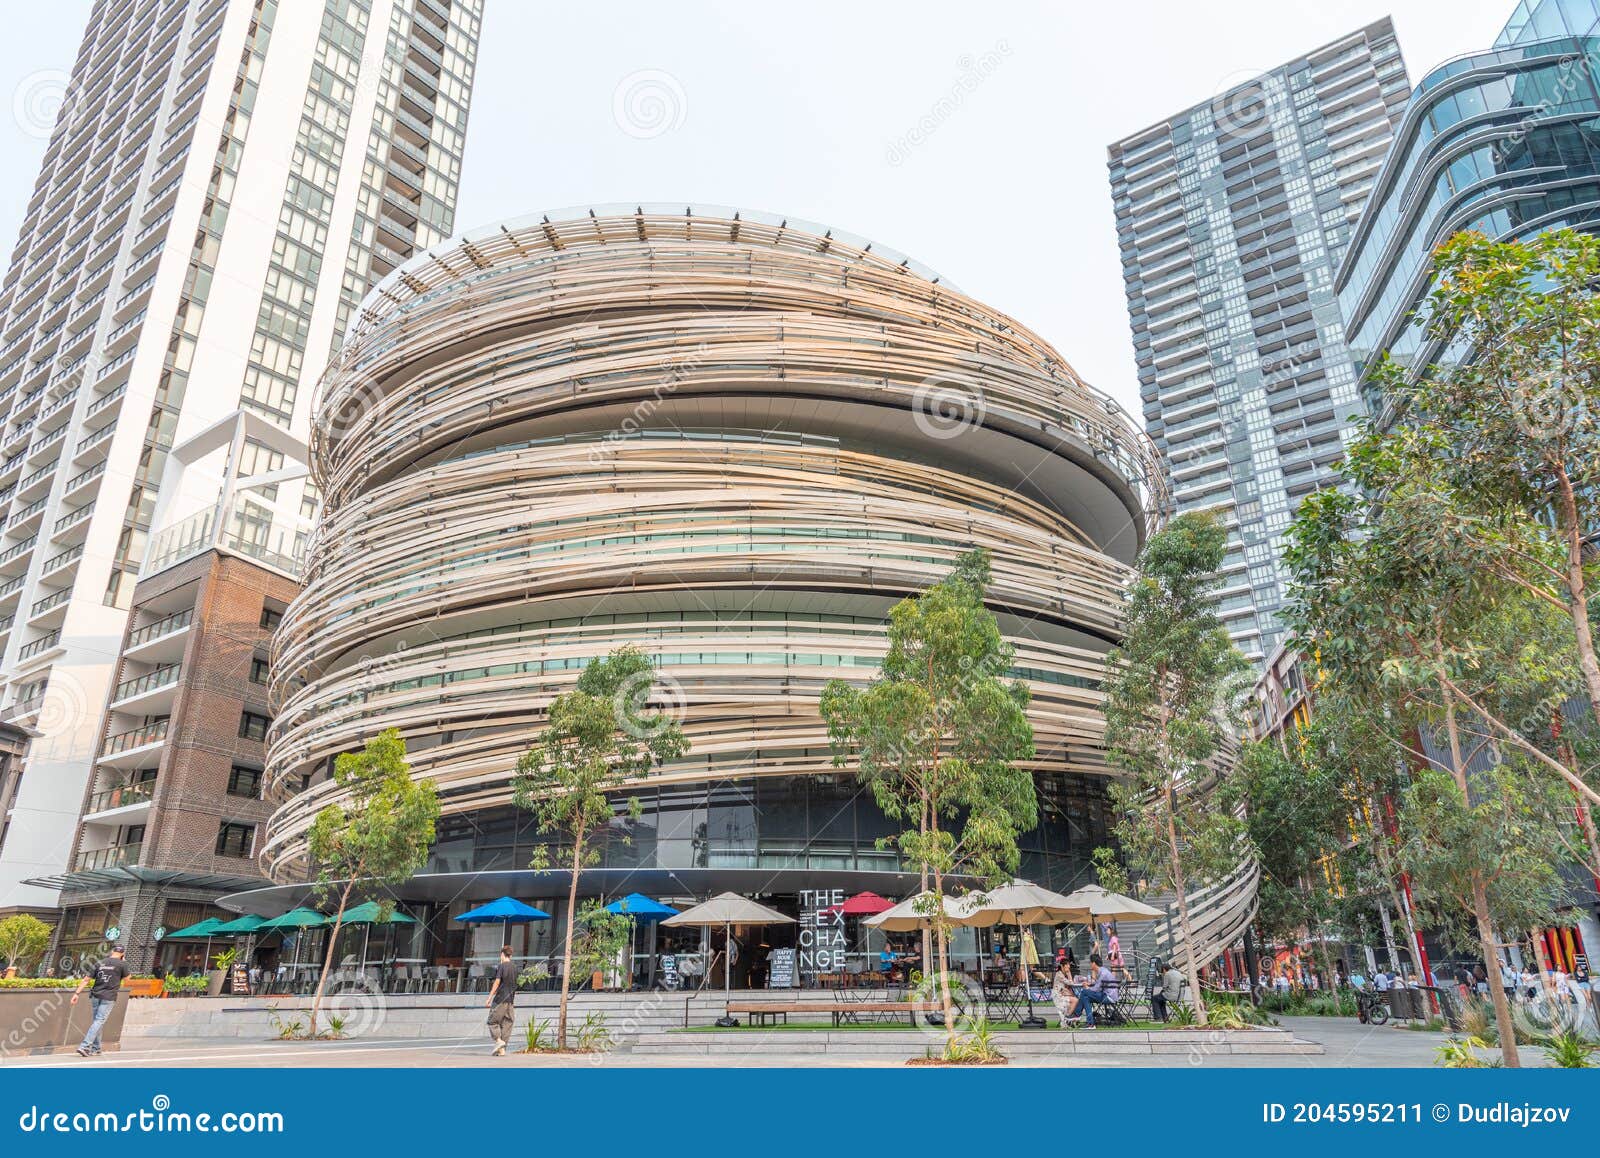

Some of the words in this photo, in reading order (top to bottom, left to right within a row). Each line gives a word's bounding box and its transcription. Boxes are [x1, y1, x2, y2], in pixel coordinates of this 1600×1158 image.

[799, 889, 844, 906] THE
[816, 909, 845, 926] EX
[799, 929, 847, 947] CHA
[800, 949, 846, 968] NGE
